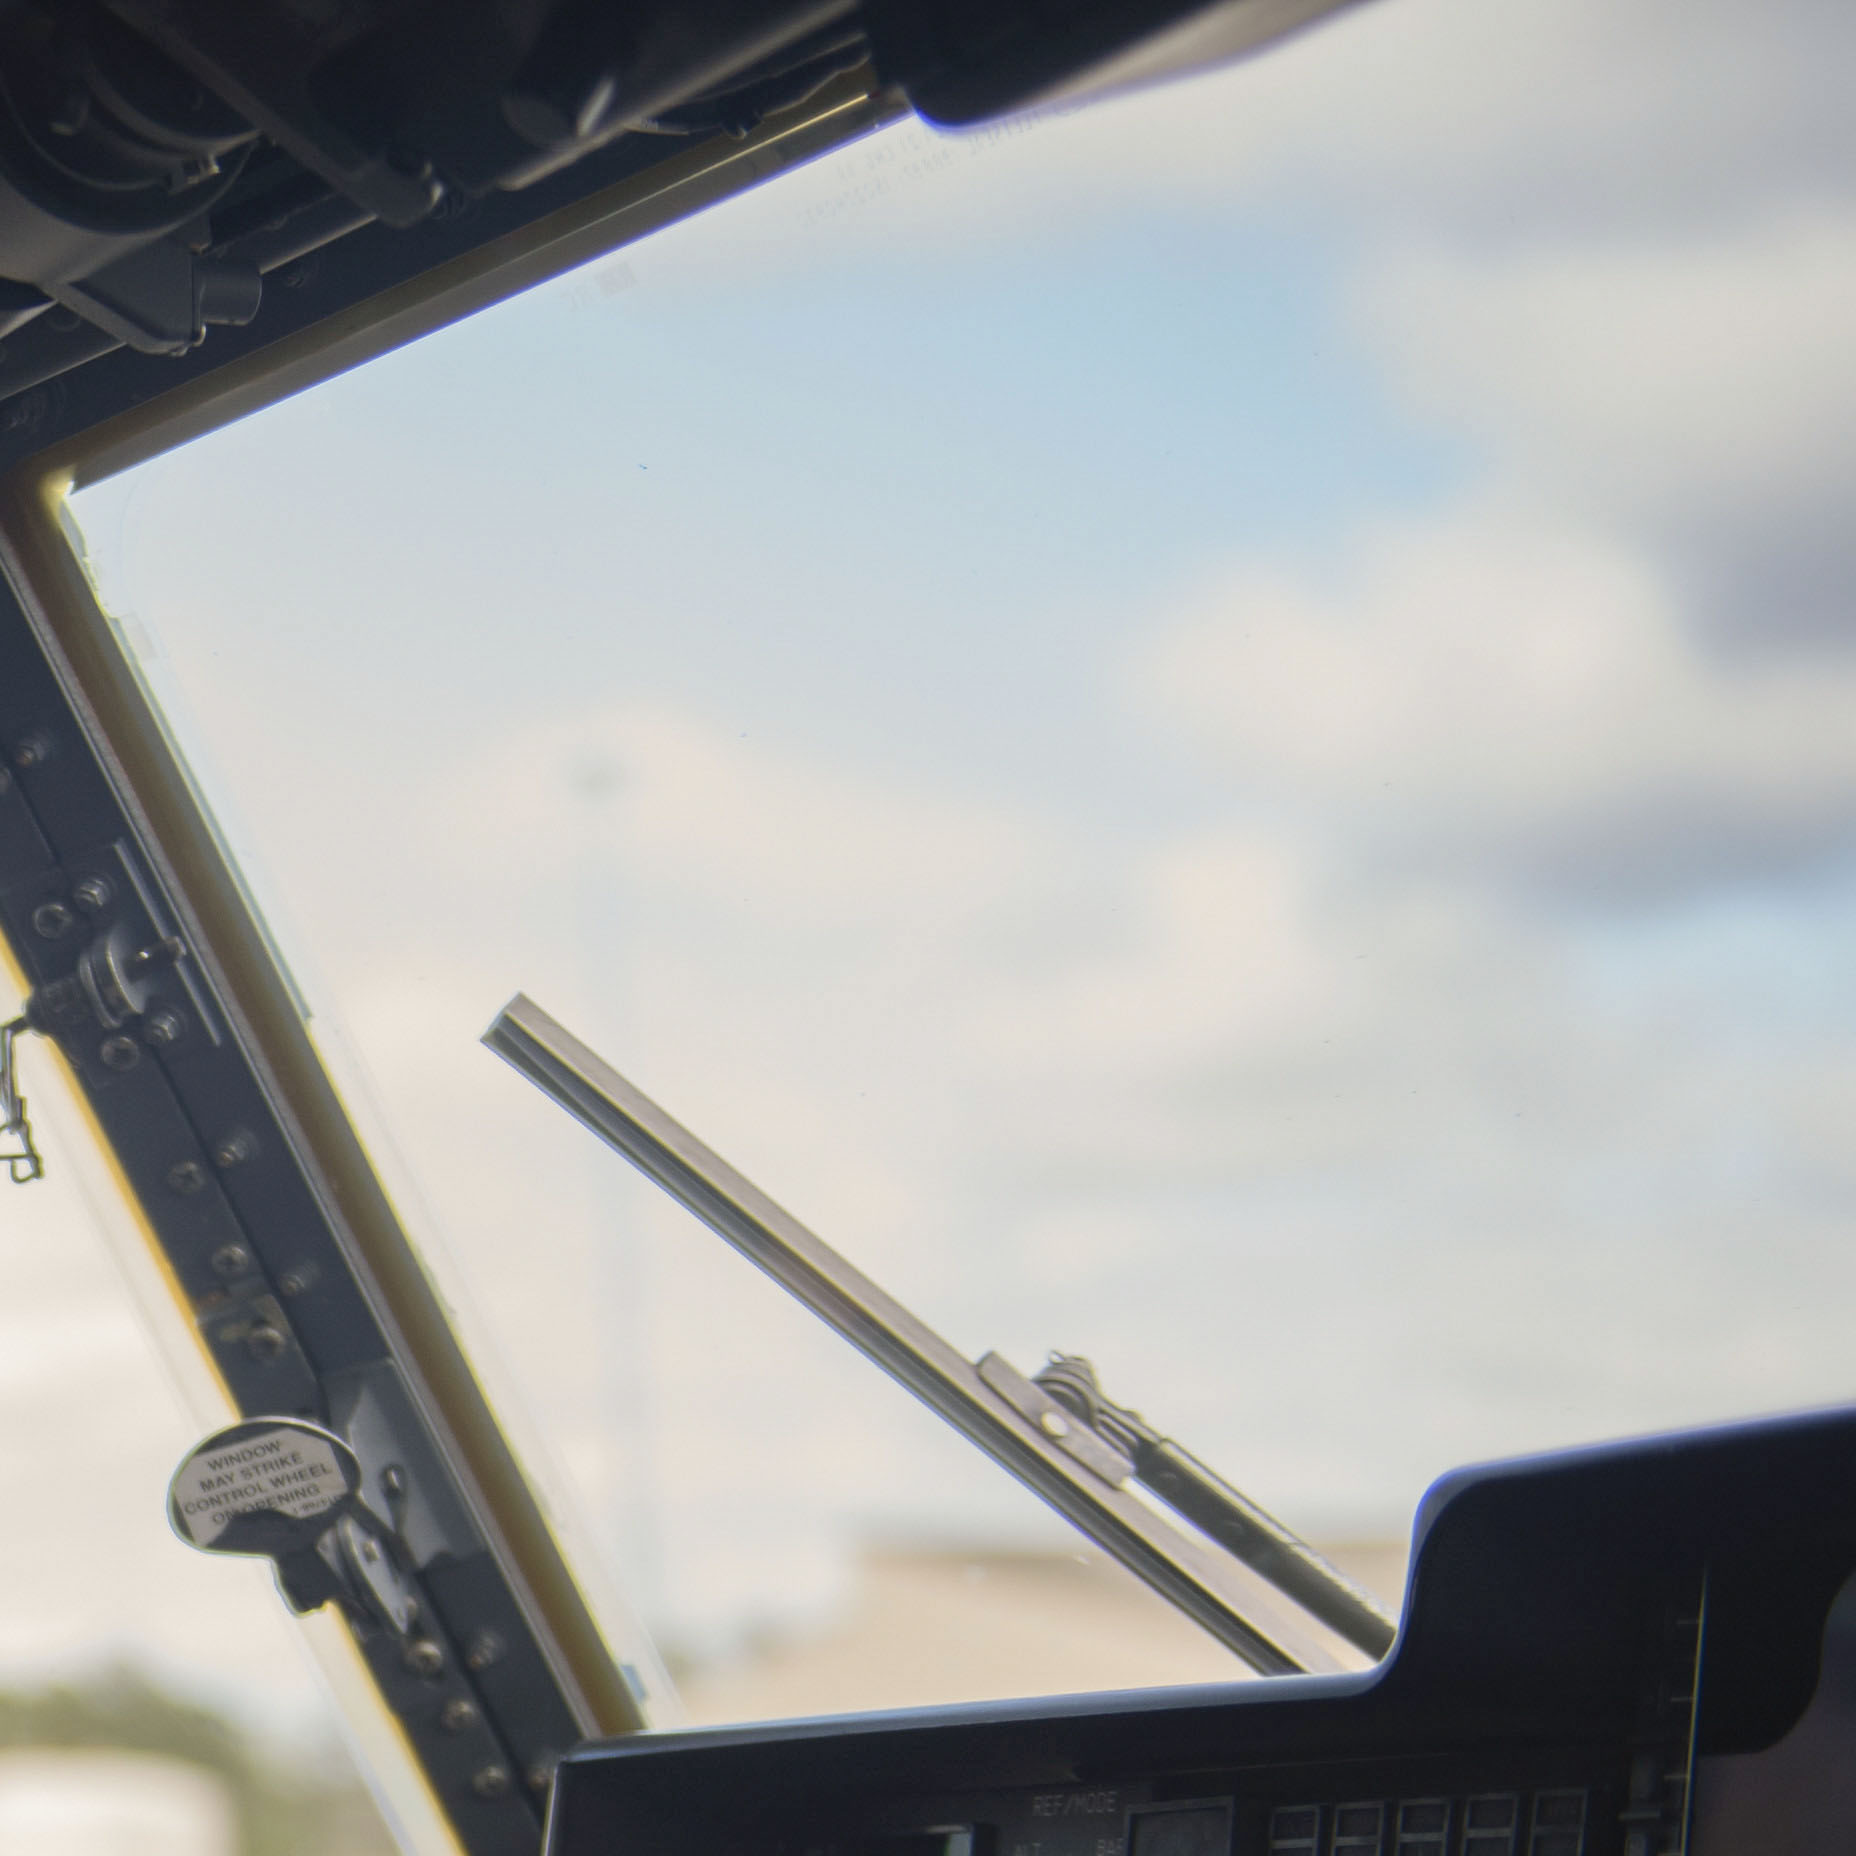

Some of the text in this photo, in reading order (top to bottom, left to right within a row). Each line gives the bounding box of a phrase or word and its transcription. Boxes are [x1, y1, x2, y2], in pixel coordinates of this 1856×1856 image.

[199, 1451, 304, 1492] MAY STRIKE
[207, 1439, 282, 1471] WINDOW
[185, 1482, 268, 1515] CONTROL
[269, 1463, 333, 1489] WHEEL
[1032, 1791, 1119, 1817] REF/MODE
